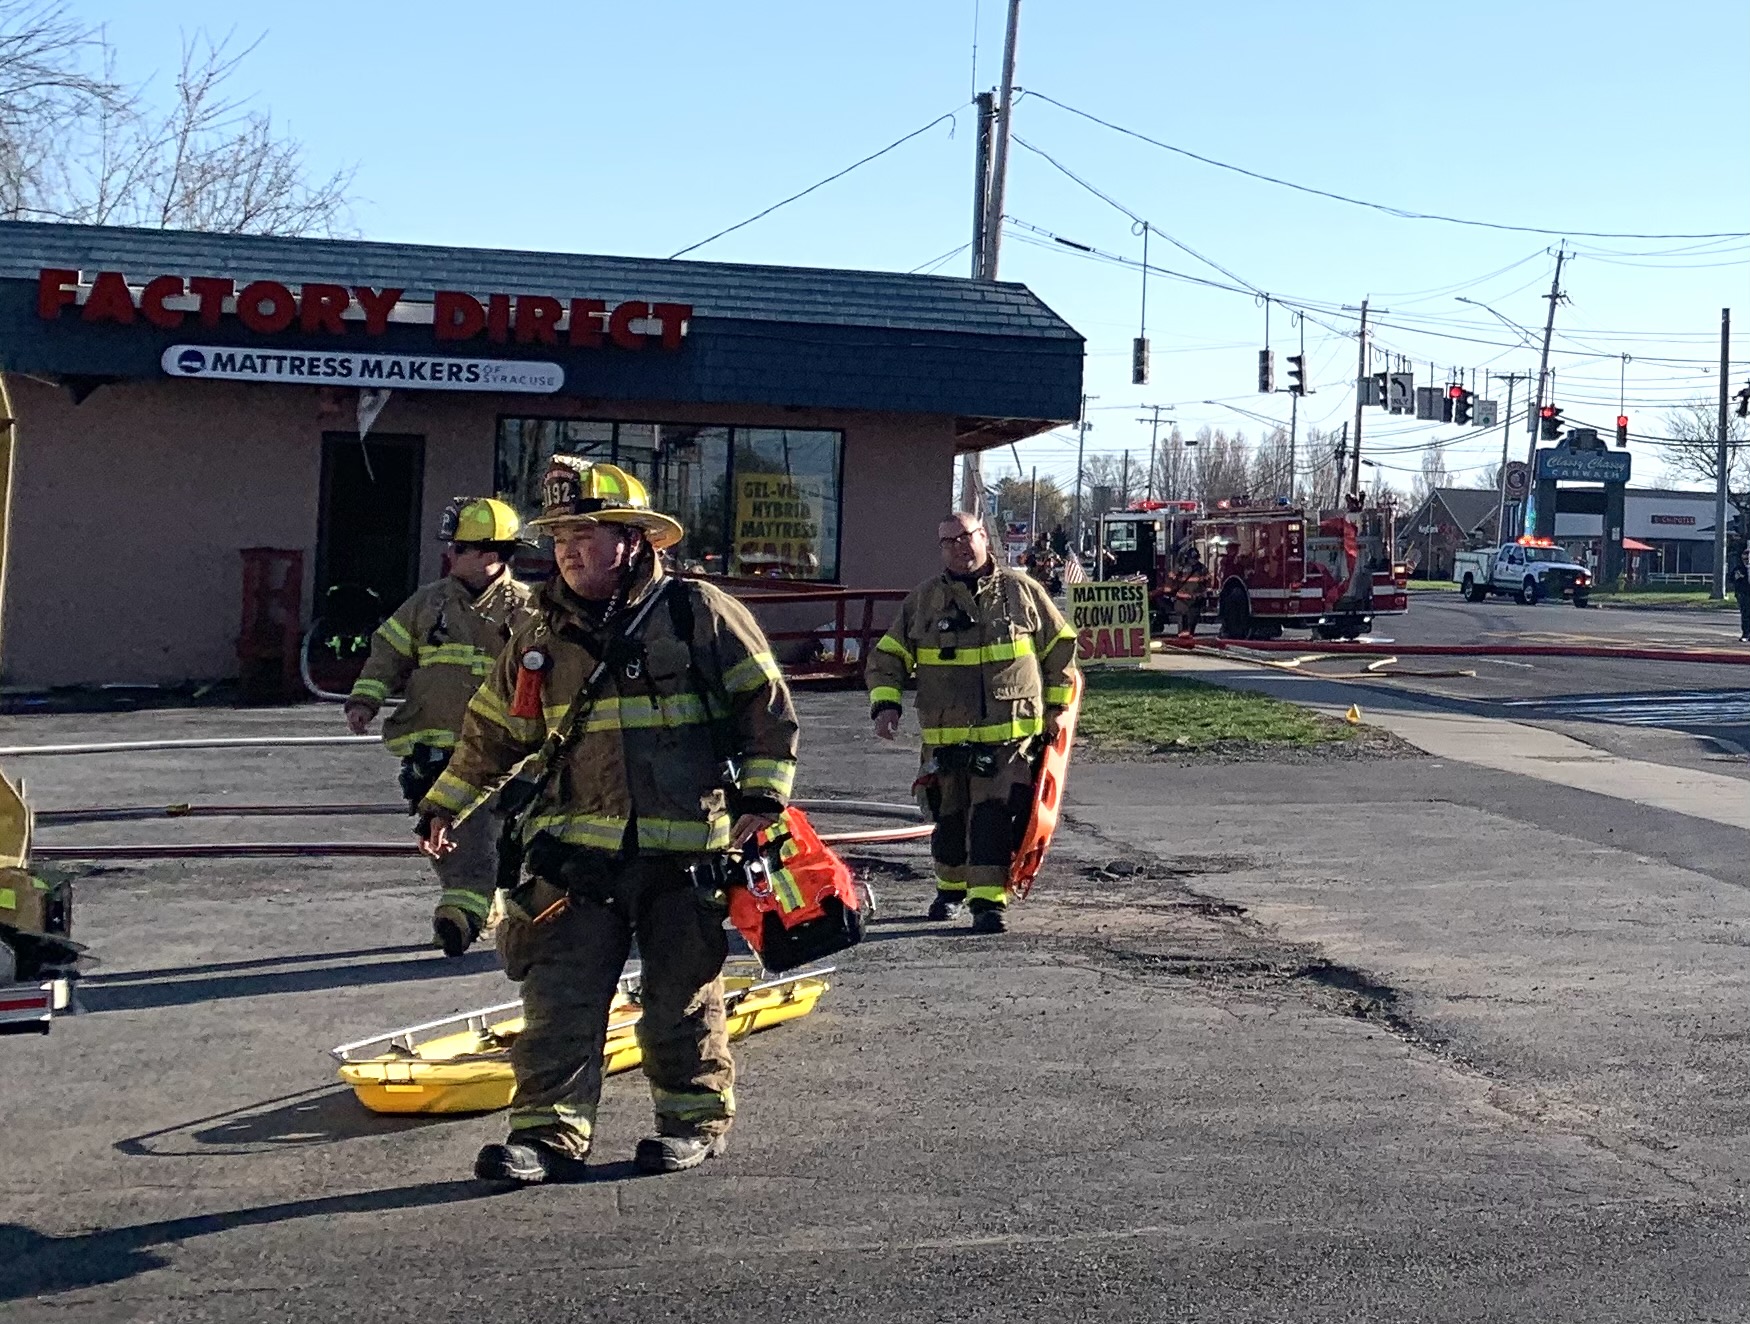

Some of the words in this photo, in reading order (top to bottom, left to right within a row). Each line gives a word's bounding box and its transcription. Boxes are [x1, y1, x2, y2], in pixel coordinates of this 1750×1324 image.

[37, 268, 404, 336] FACTORY
[434, 290, 693, 350] DIRECT
[211, 352, 353, 378] MATTRESS
[358, 358, 481, 383] MAKERS
[482, 364, 501, 374] OF
[482, 373, 555, 386] SYRACUSE
[1073, 585, 1144, 602] MATTRESS
[1074, 604, 1114, 629] BLOW
[1077, 627, 1147, 660] SALE
